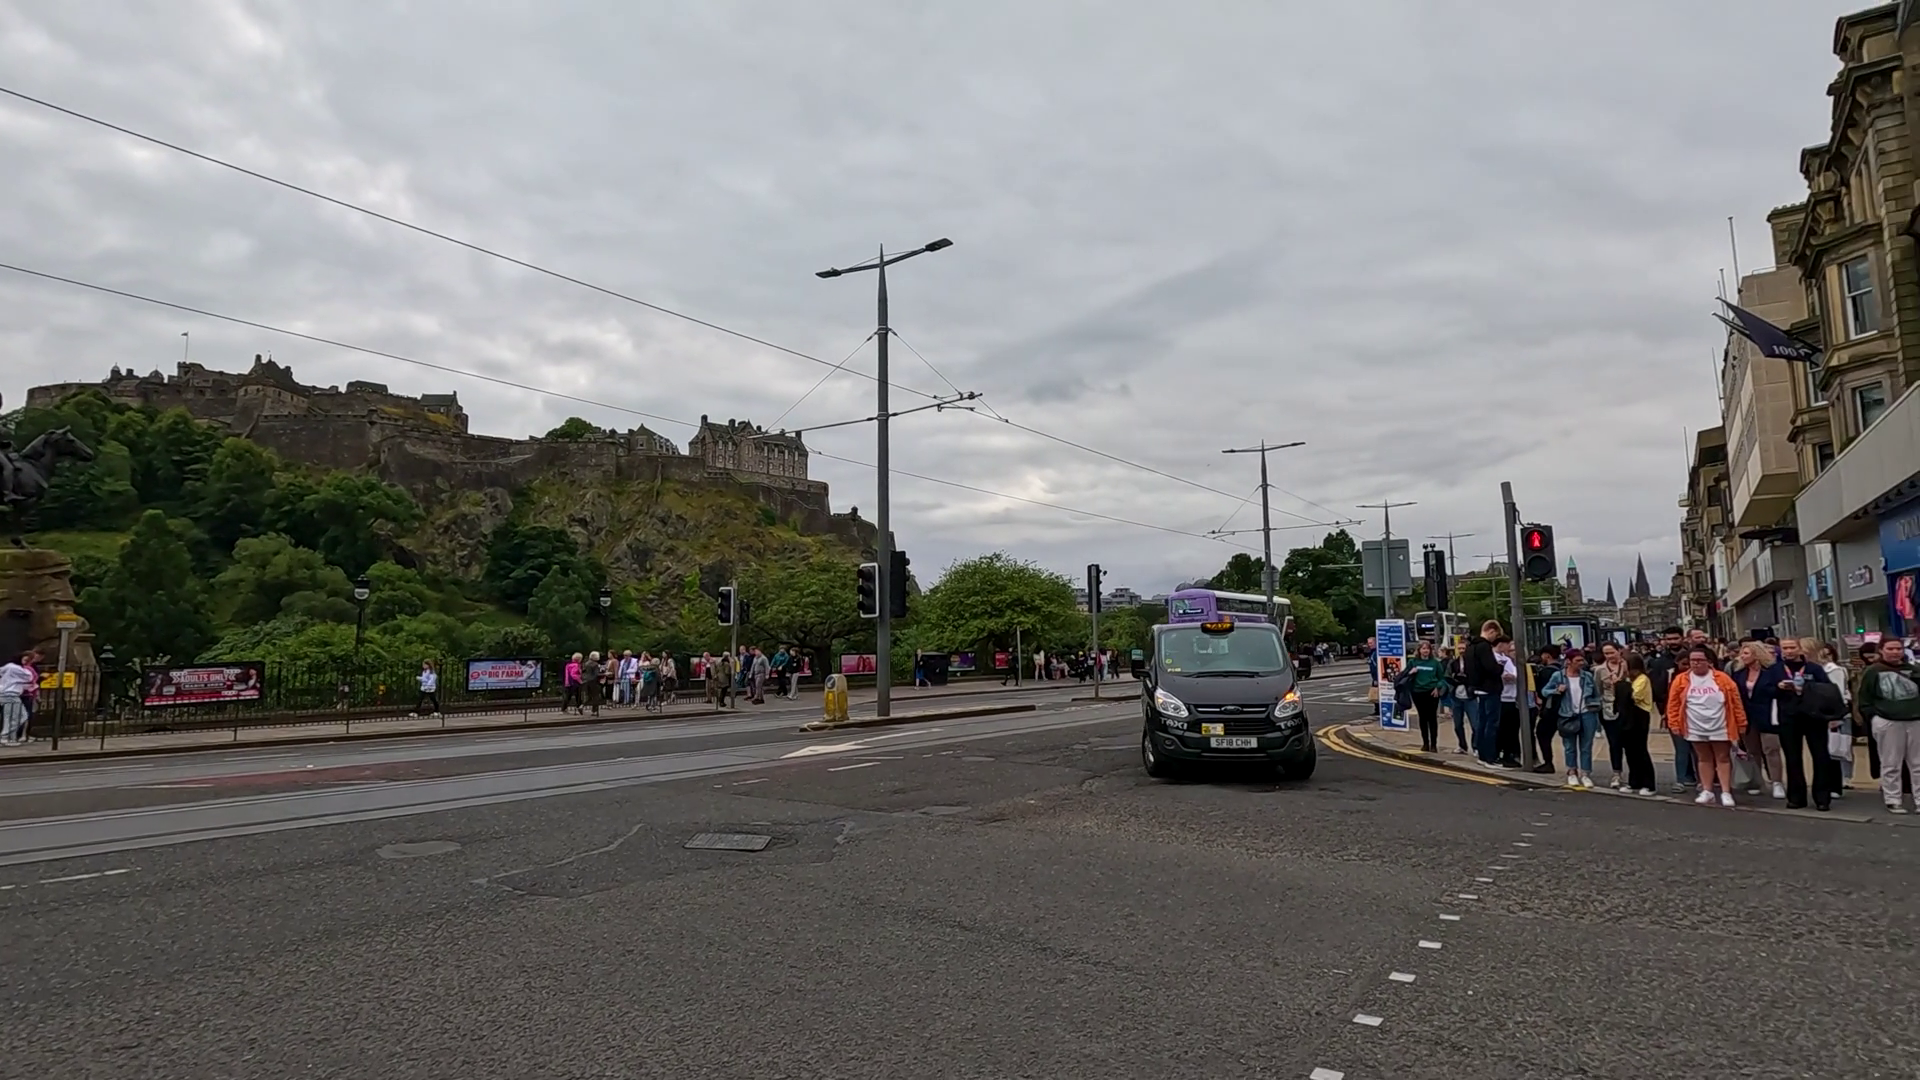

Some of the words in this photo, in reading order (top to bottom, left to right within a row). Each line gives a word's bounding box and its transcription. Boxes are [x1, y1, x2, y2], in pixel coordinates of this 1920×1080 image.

[1772, 345, 1797, 357] 100
[181, 674, 208, 682] ADULTS
[209, 673, 228, 681] ONLY
[1160, 717, 1188, 730] TAXI
[1215, 738, 1234, 746] SF18
[1235, 738, 1252, 746] CHH
